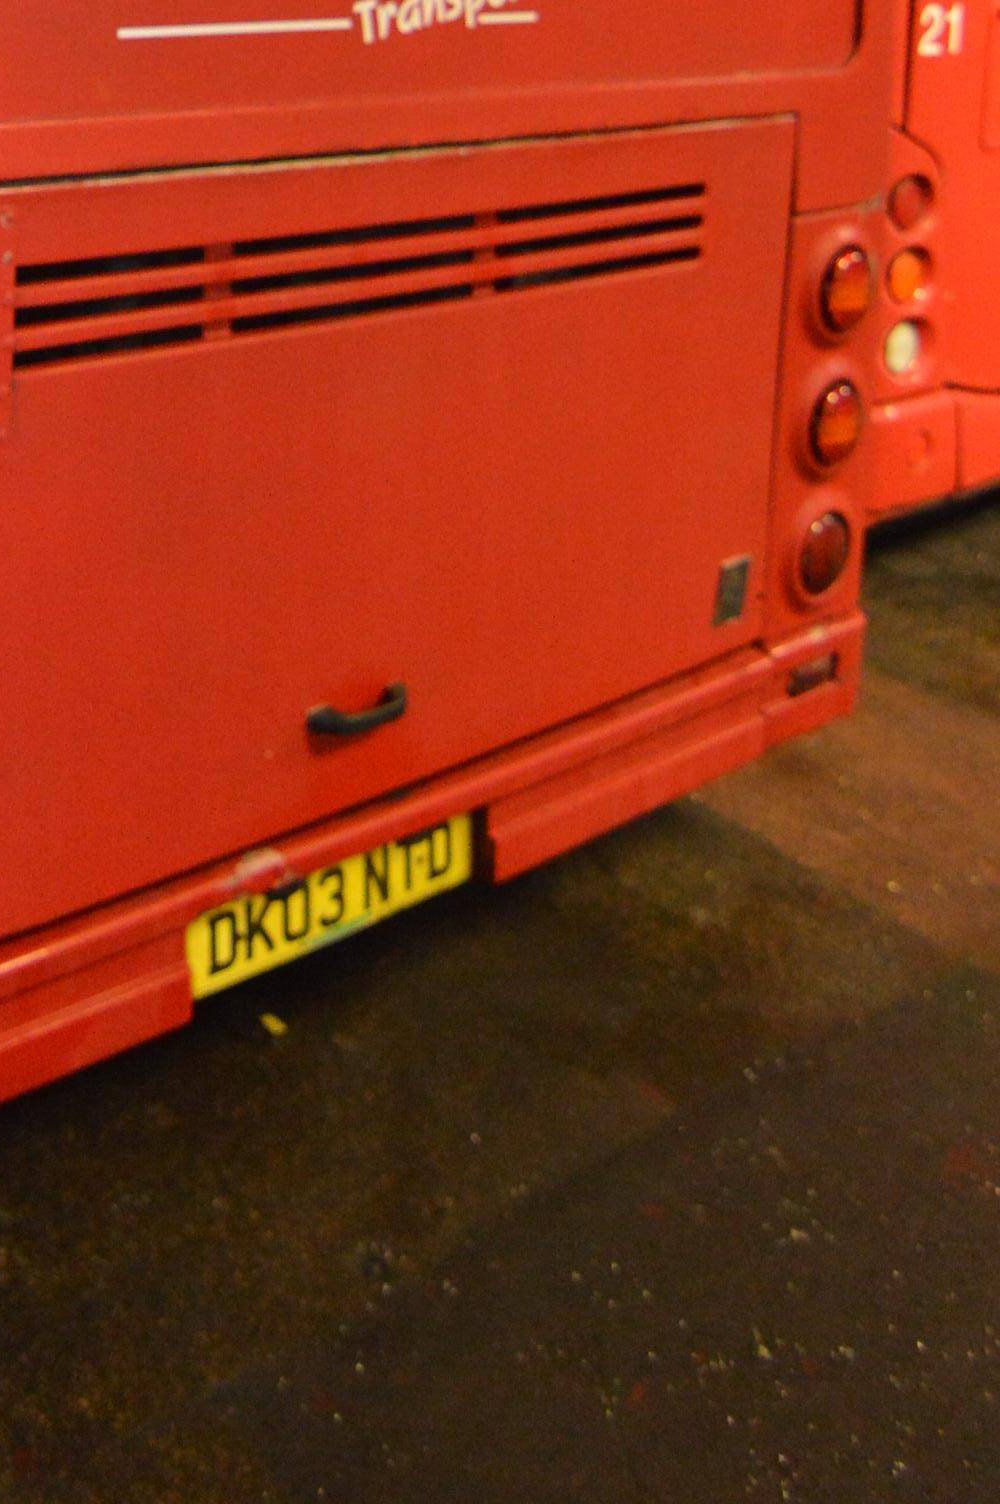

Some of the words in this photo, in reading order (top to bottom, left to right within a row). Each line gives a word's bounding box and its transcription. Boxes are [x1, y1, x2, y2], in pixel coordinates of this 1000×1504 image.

[917, 1, 965, 57] 21
[208, 866, 345, 974] DK03
[363, 824, 451, 910] NTD
